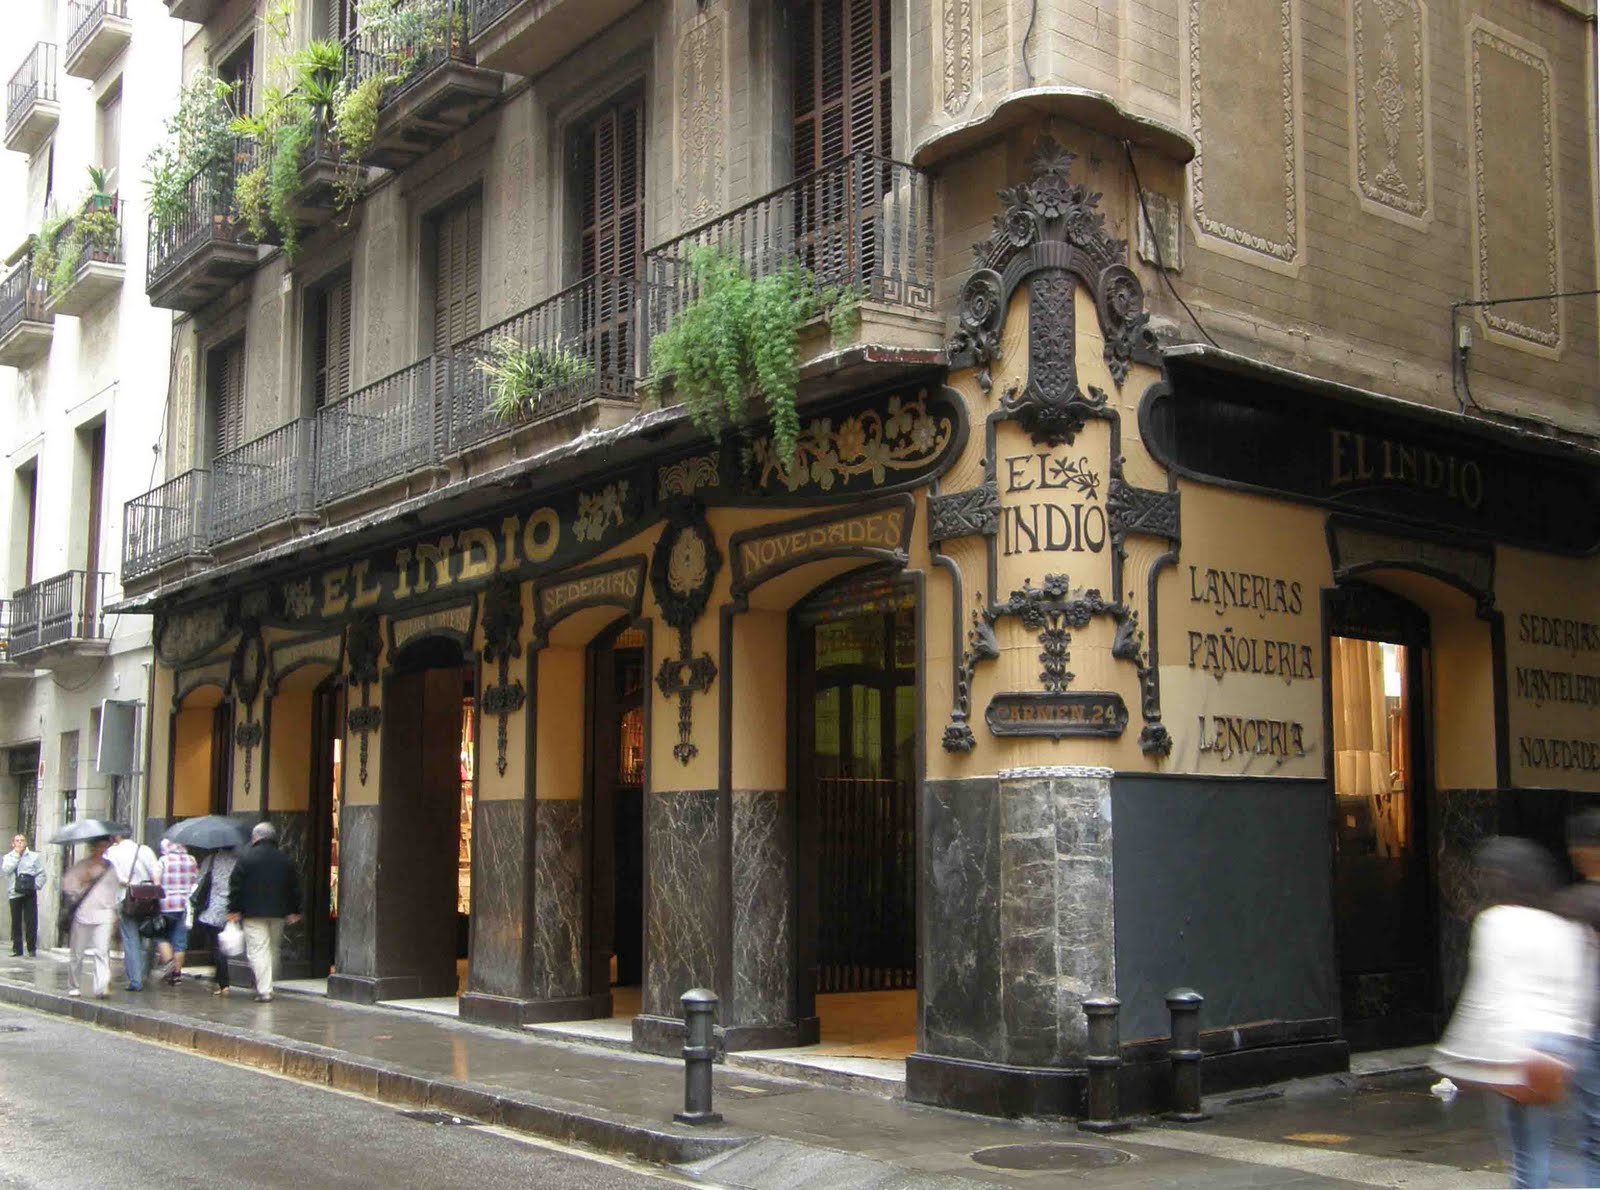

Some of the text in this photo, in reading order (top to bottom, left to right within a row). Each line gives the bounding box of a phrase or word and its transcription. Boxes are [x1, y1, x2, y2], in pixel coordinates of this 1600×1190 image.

[1005, 453, 1069, 494] EL
[1329, 427, 1483, 510] EL INDIO
[742, 512, 900, 576] NOVEDADES
[1002, 503, 1106, 556] INDIO
[320, 507, 561, 617] EL INDIO
[543, 568, 638, 616] SEDERIAS
[1189, 565, 1303, 619] LANERIAS
[1187, 627, 1314, 686] PAÑOLERIA
[1198, 715, 1306, 766] LENCERIA
